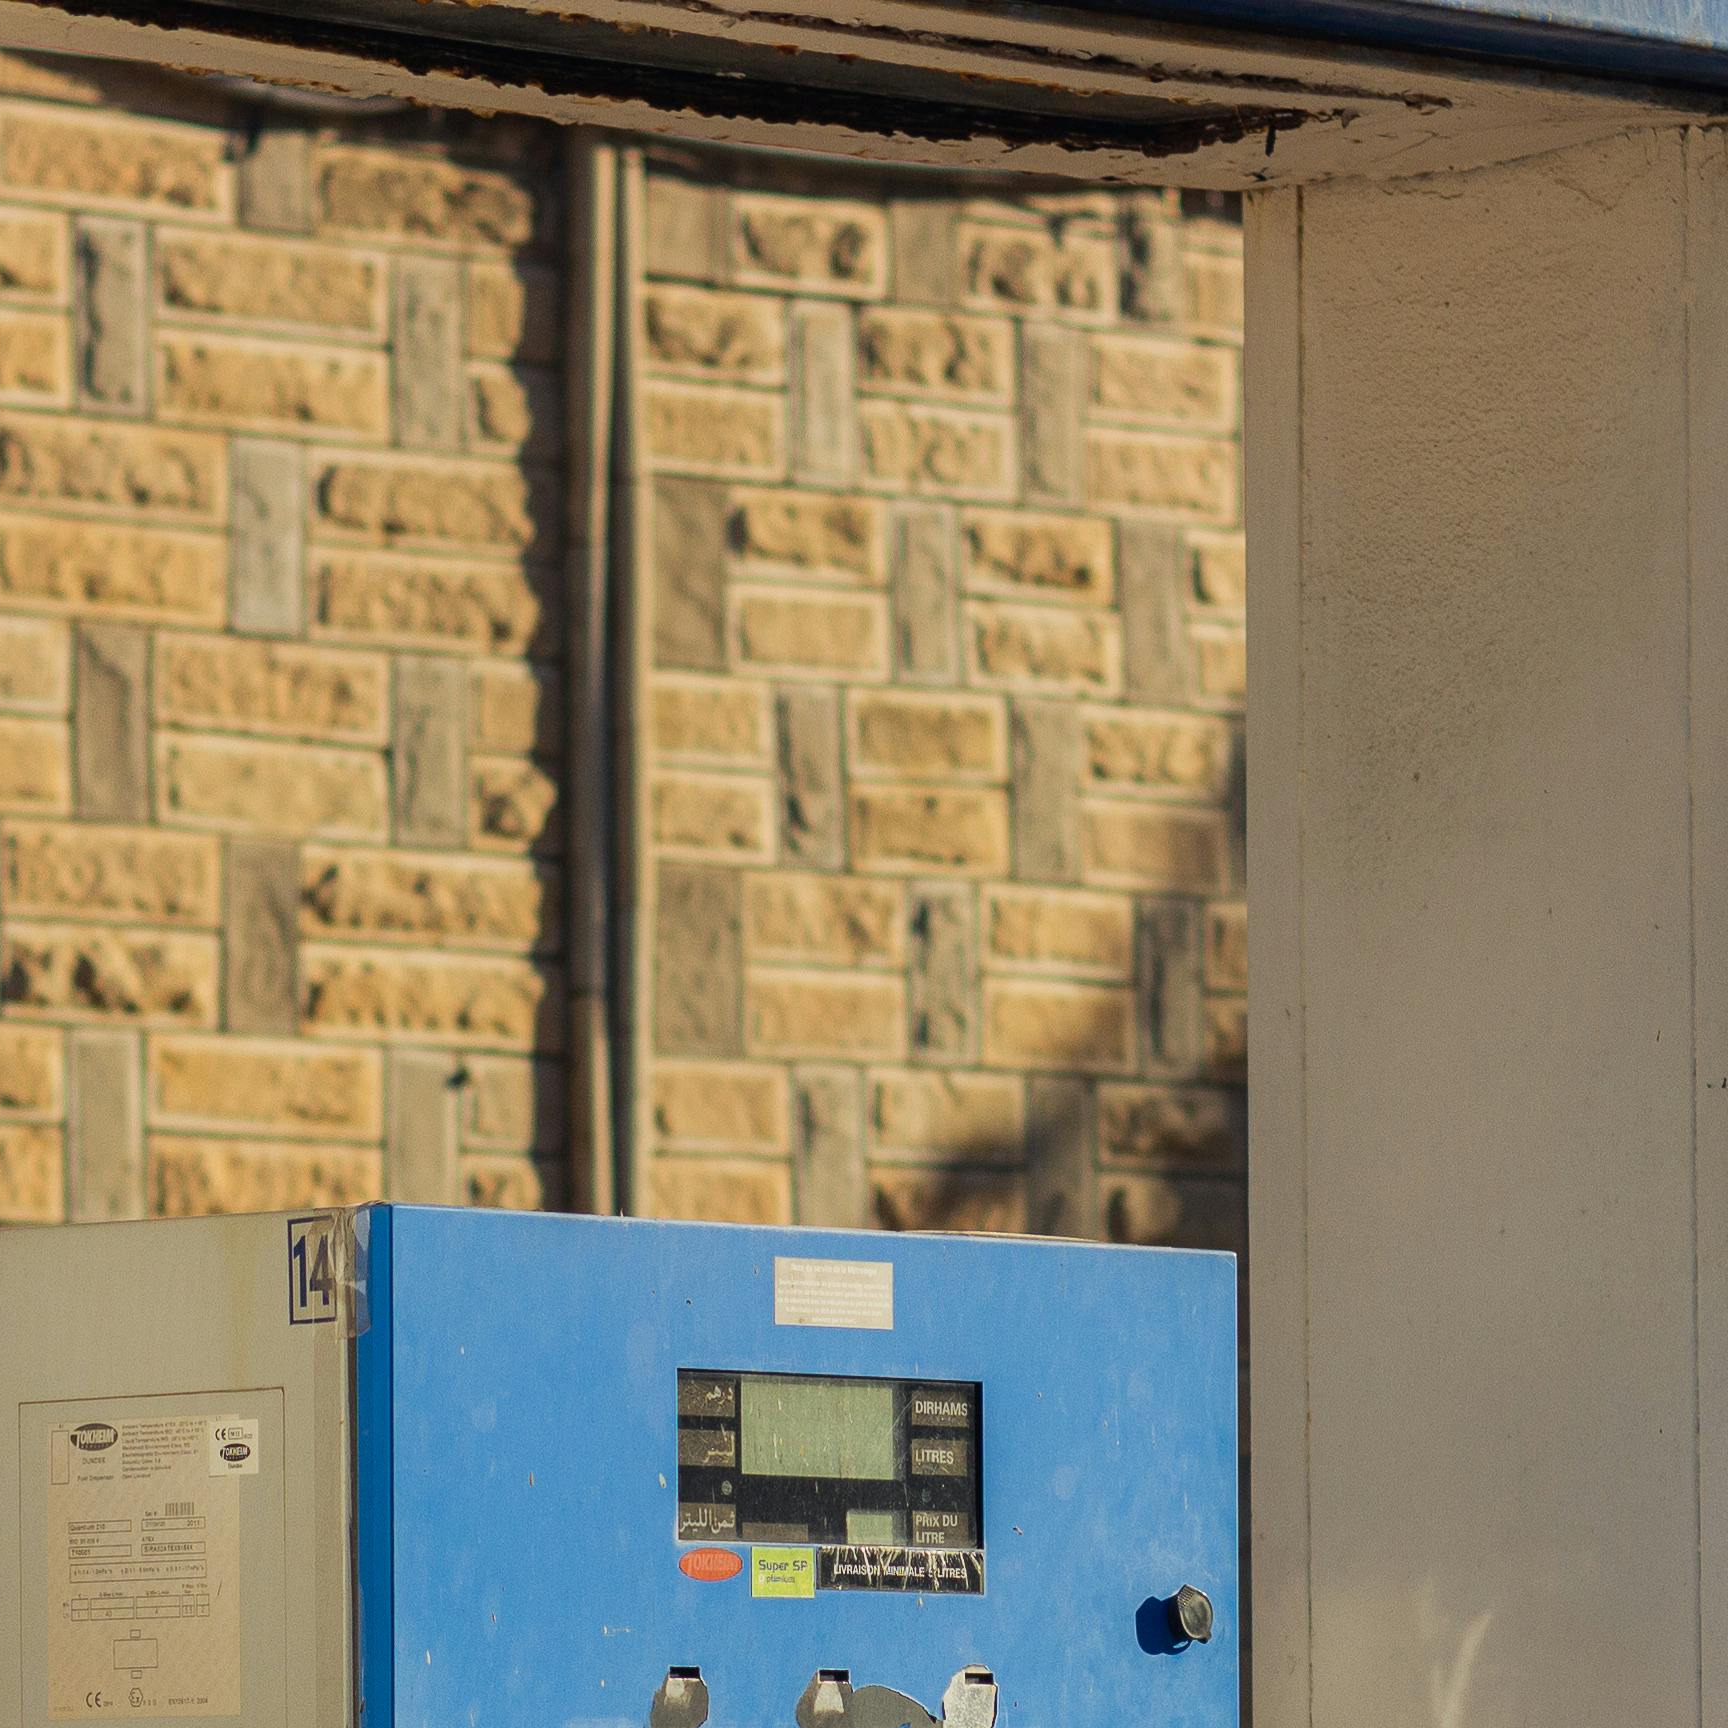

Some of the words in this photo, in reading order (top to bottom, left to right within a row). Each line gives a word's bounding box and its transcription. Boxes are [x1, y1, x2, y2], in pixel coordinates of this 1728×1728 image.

[293, 1234, 333, 1308] 14
[915, 1401, 968, 1417] DIRHAMS
[72, 1427, 116, 1448] TOKHEIM
[915, 1449, 955, 1465] LITRES
[915, 1514, 940, 1528] PRIX
[942, 1514, 958, 1528] DU
[915, 1531, 946, 1545] LITRE
[758, 1559, 789, 1573] Super
[794, 1560, 808, 1573] SP
[833, 1563, 881, 1577] LIVRAISON
[937, 1566, 969, 1579] LITRES
